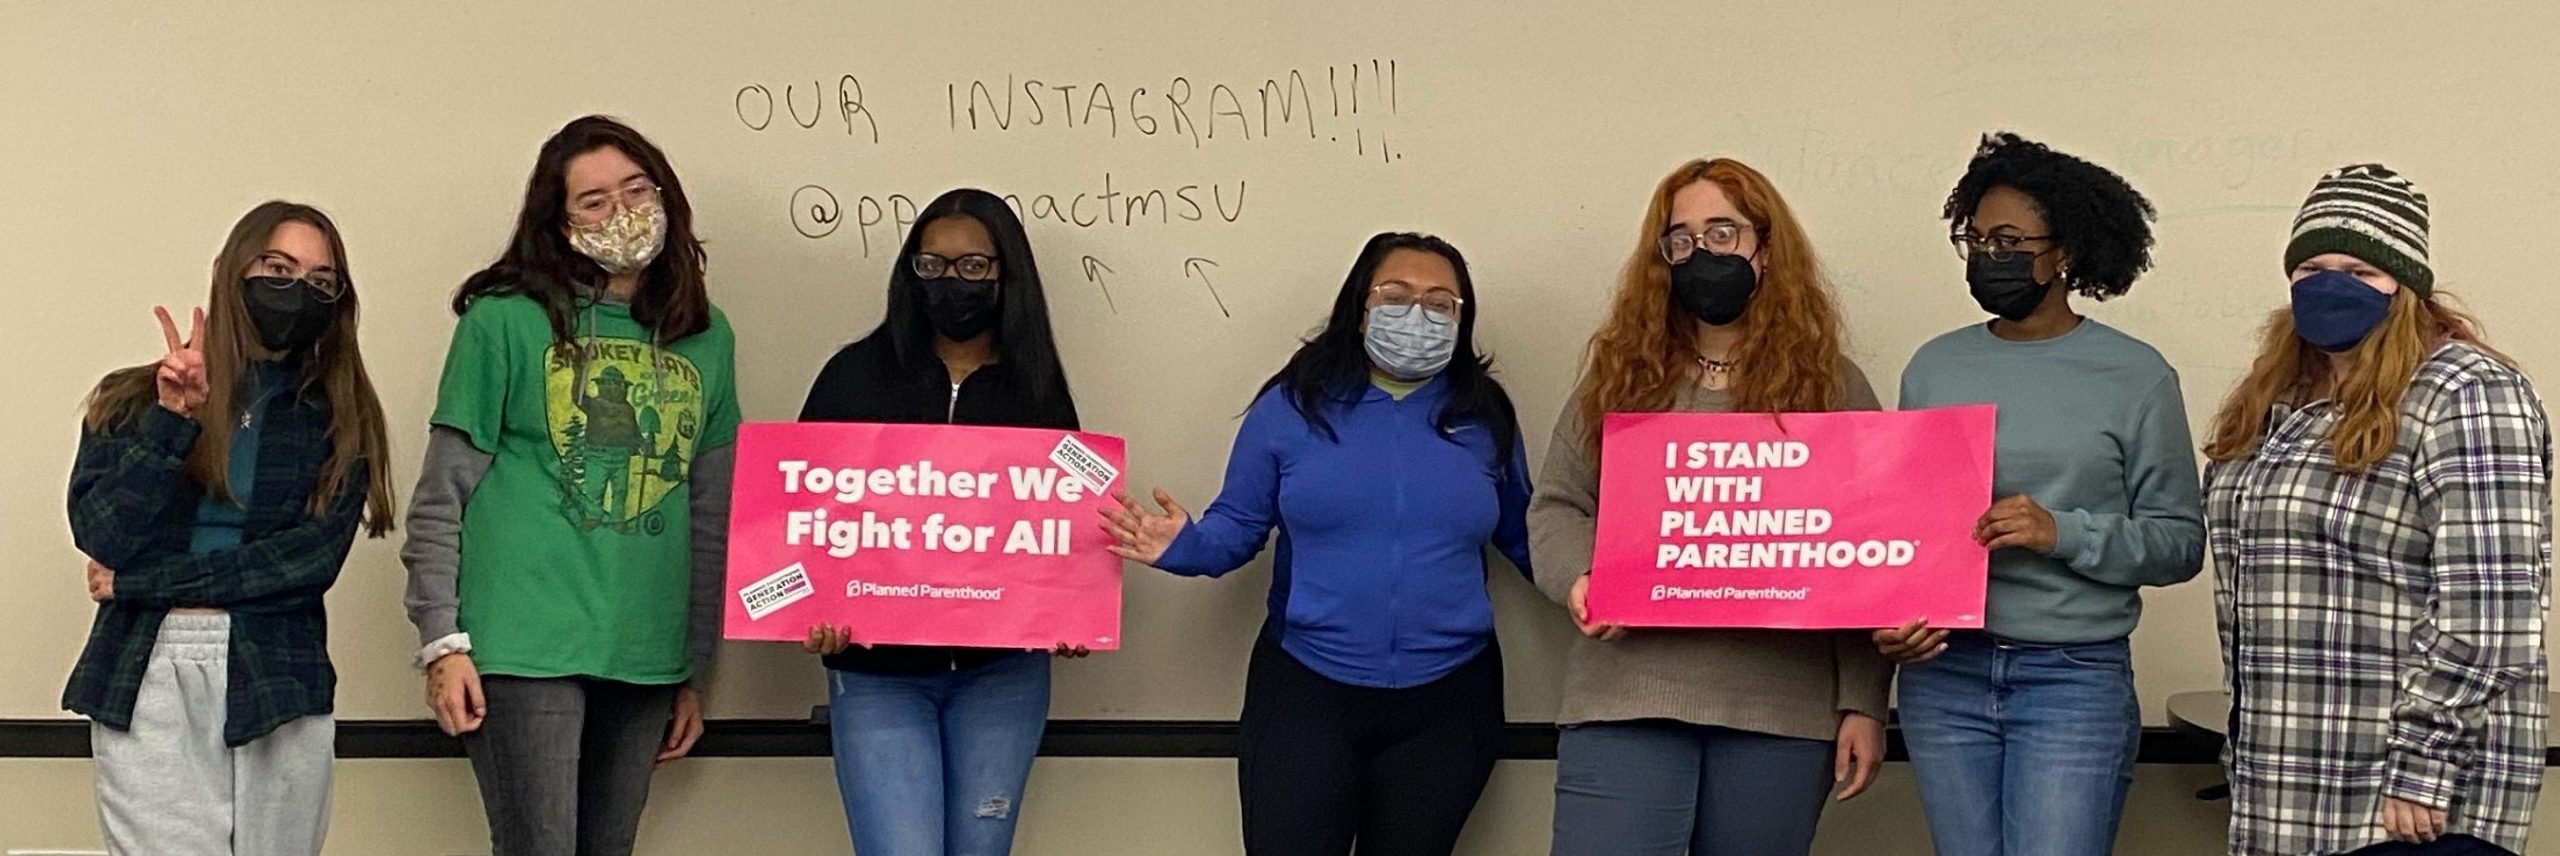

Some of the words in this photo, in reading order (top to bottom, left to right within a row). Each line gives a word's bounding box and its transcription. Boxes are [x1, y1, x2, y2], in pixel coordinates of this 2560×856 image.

[735, 74, 878, 144] OUR
[947, 58, 1403, 164] INSTAGRAM!!!!
[1056, 449, 1087, 473] ACTION
[1062, 443, 1111, 482] GENERATION
[1666, 442, 1677, 469] I
[1686, 441, 1810, 469] STAND
[778, 460, 999, 504] Together
[1008, 466, 1084, 503] We
[1665, 476, 1762, 503] WITH
[786, 507, 912, 558] Fight
[921, 513, 995, 553] for
[1003, 518, 1071, 555] All
[1660, 508, 1832, 537] PLANNED
[746, 572, 804, 604] GENERATION
[750, 590, 784, 611] ACTION
[862, 582, 919, 597] Planned
[920, 584, 1001, 600] Parenthood
[1666, 587, 1723, 599] Planned
[1723, 587, 1806, 600] Parenthood
